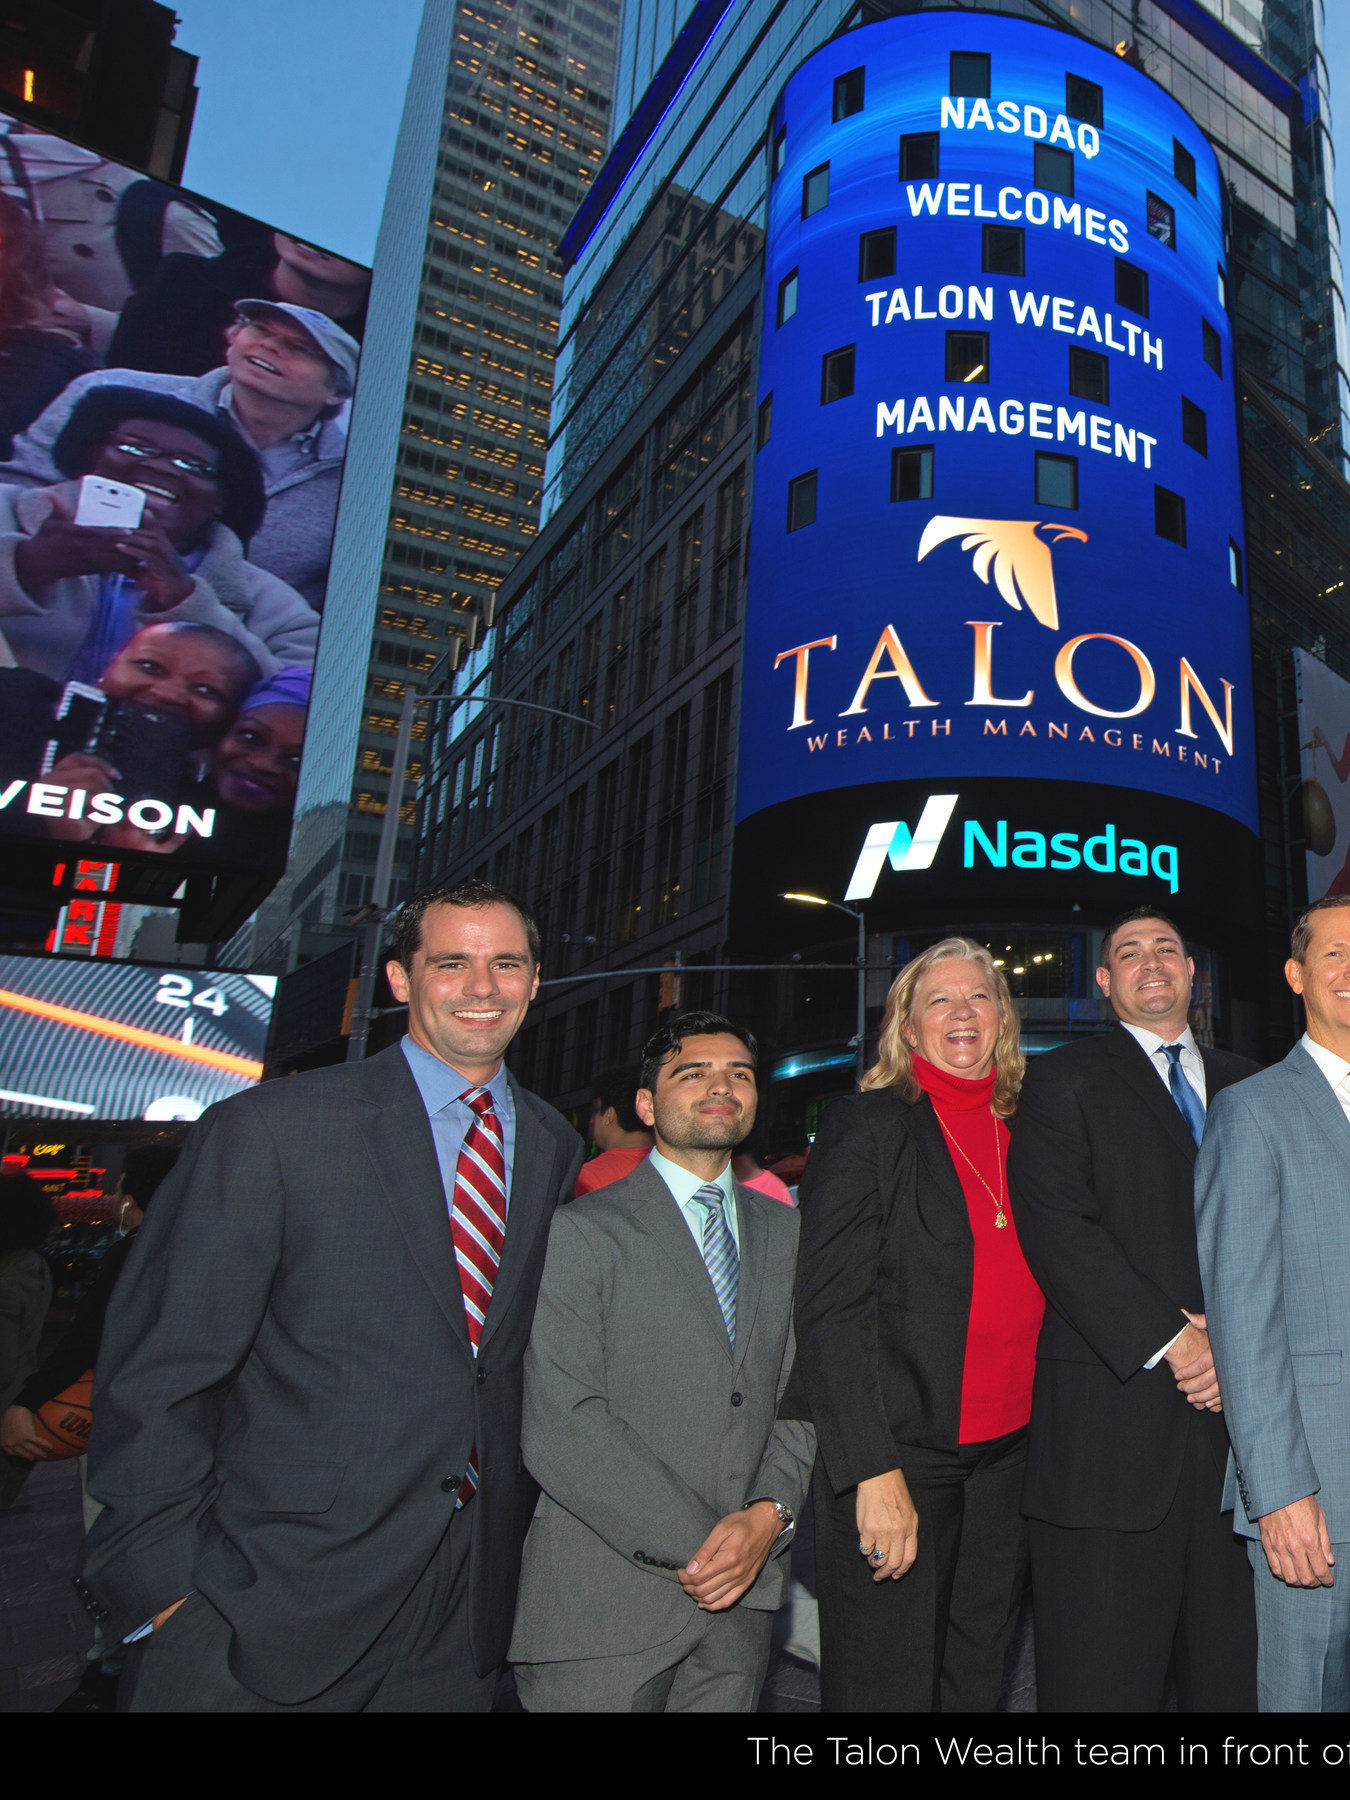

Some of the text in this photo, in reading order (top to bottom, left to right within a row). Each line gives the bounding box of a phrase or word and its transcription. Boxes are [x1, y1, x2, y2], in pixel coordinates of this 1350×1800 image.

[941, 97, 1100, 160] NASDAQ
[907, 183, 1130, 254] WELCOMES
[865, 285, 1164, 371] TALON WEALTH
[876, 396, 1158, 470] MANAGEMENT
[773, 621, 1235, 756] TALON
[806, 717, 1224, 775] WEALTH MANAGEMENT
[963, 820, 1180, 895] Nasdaq
[156, 974, 229, 1016] 24
